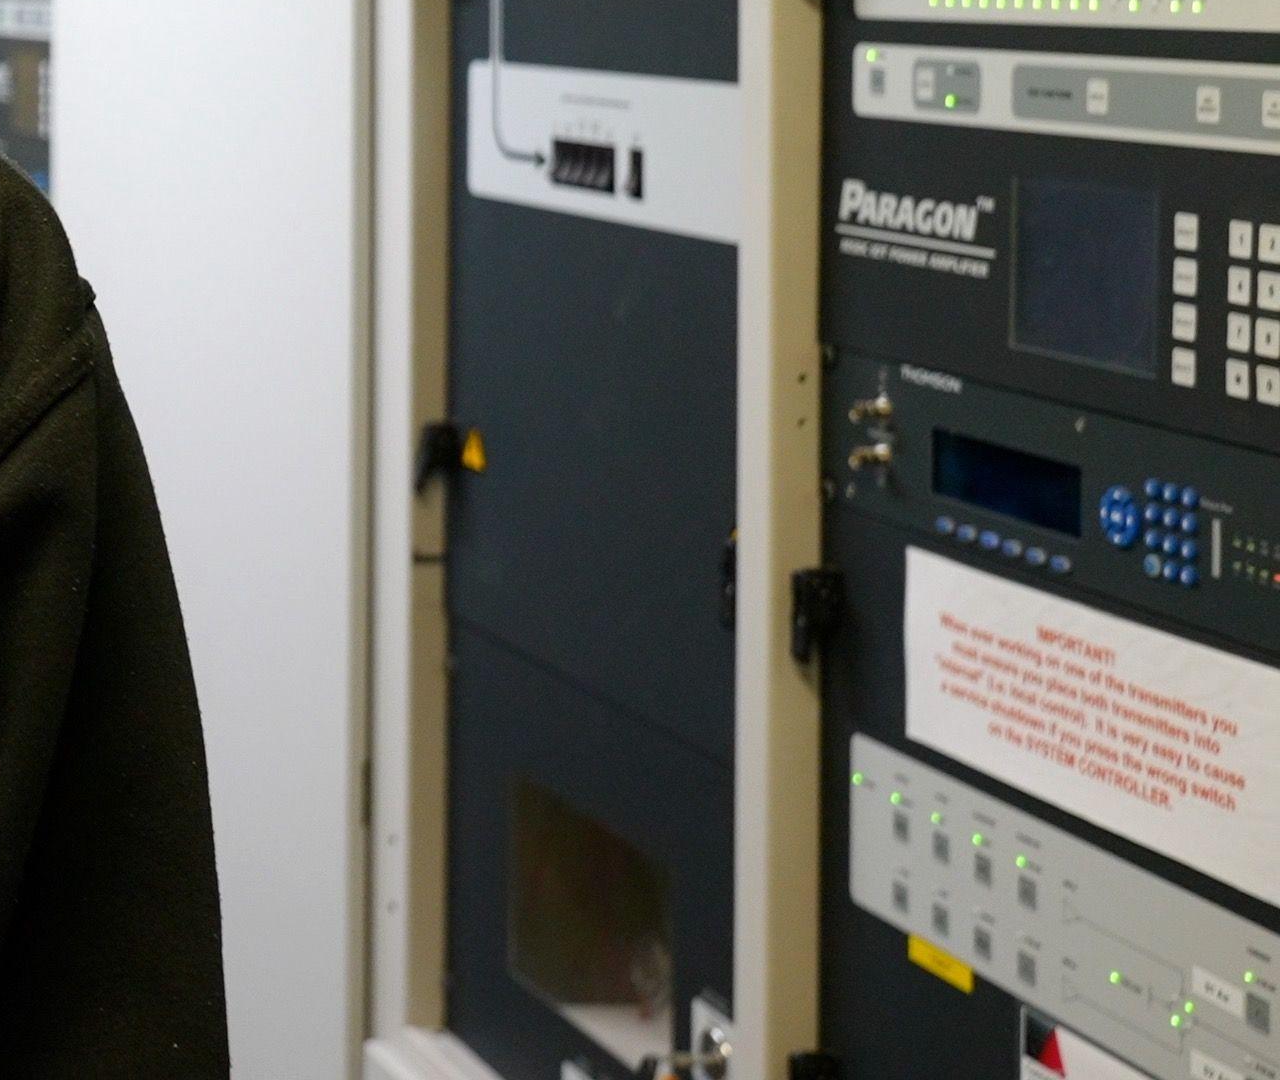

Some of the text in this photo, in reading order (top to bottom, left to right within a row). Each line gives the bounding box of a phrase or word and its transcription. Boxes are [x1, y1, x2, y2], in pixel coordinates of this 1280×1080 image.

[838, 178, 978, 242] PARAGON
[997, 638, 1043, 667] working
[1063, 661, 1086, 680] one
[1105, 674, 1125, 695] the
[1127, 682, 1208, 725] transmitters
[1212, 714, 1239, 738] you
[1022, 670, 1043, 685] you
[1046, 677, 1078, 701] place
[1080, 688, 1108, 710] both
[1111, 700, 1190, 744] transmitters
[1193, 729, 1221, 756] into
[1025, 733, 1076, 768] SYSTEM
[1059, 730, 1082, 748] you
[1084, 739, 1119, 764] press
[1122, 752, 1143, 772] the
[1145, 764, 1188, 795] wrong
[1190, 781, 1237, 812] switch
[1121, 732, 1149, 755] very
[1151, 742, 1183, 768] easy
[1186, 754, 1200, 772] to
[1203, 763, 1246, 792] cause
